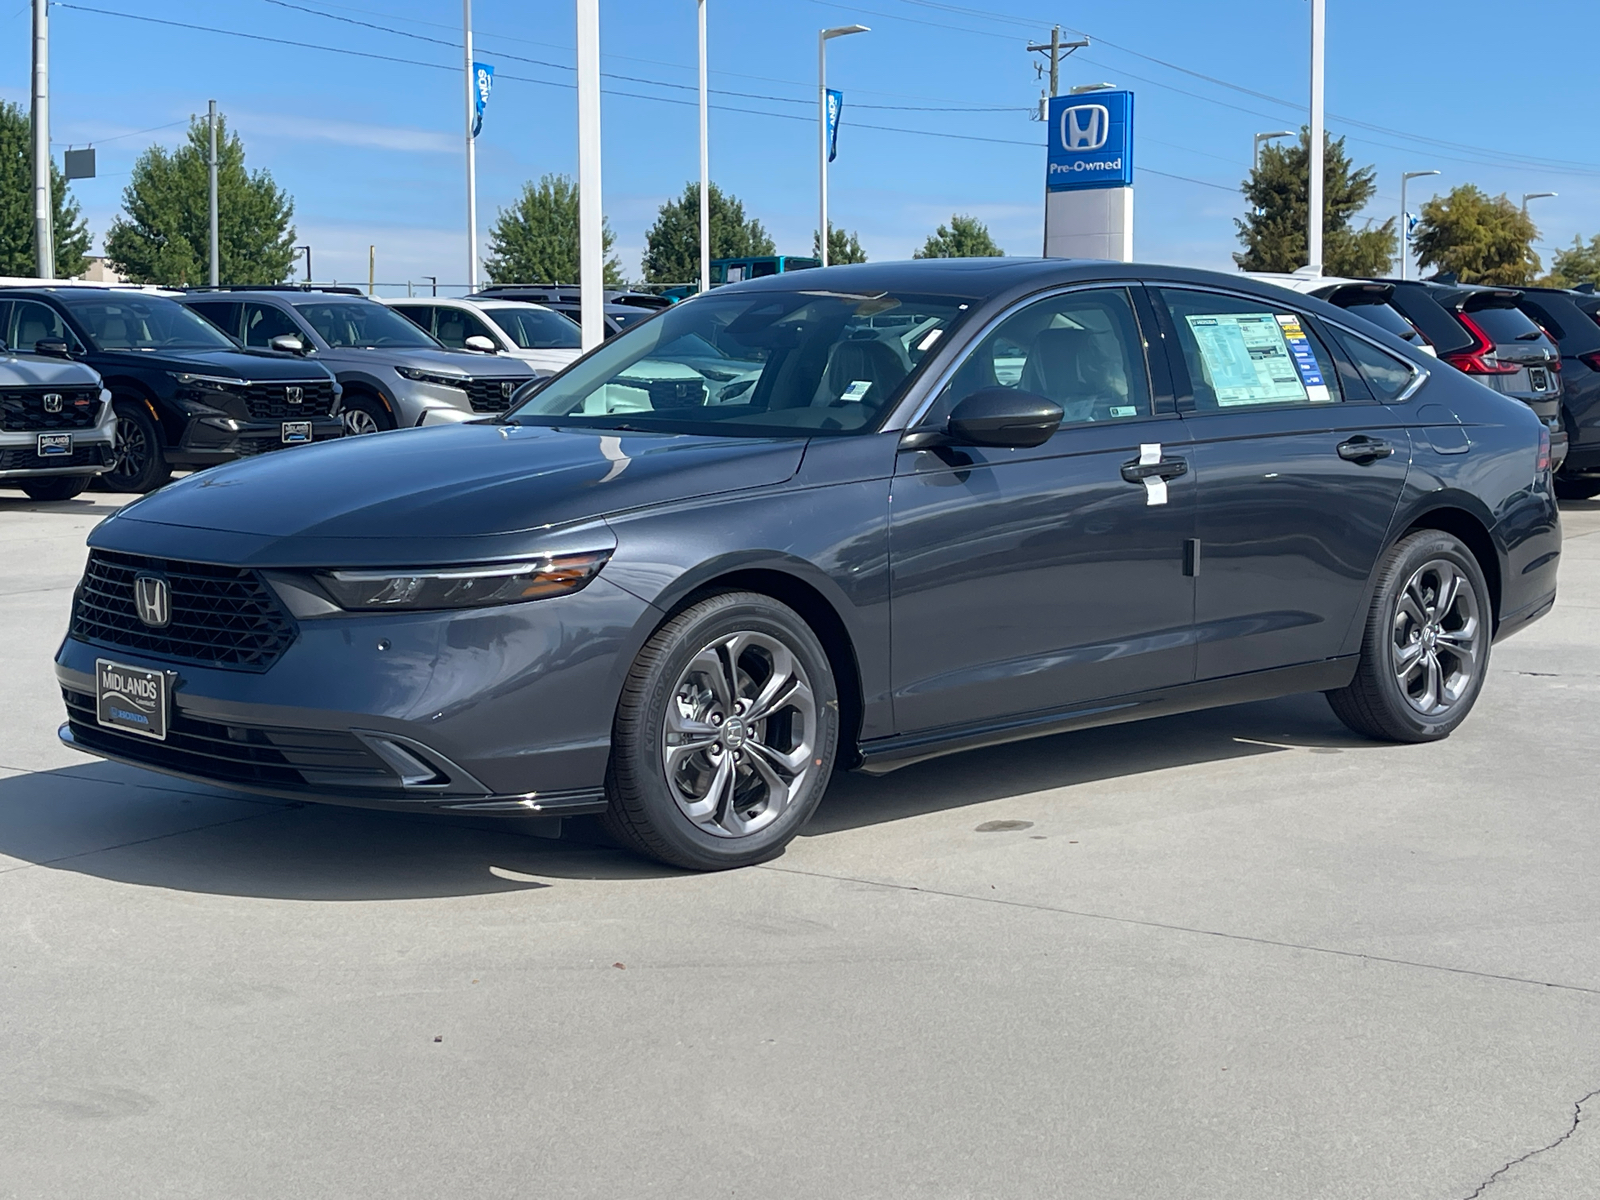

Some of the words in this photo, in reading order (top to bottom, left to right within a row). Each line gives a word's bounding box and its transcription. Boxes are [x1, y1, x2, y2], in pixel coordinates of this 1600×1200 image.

[1050, 158, 1121, 174] Pre-Owned
[102, 671, 157, 700] MIDLANDS
[118, 711, 149, 724] HONDA
